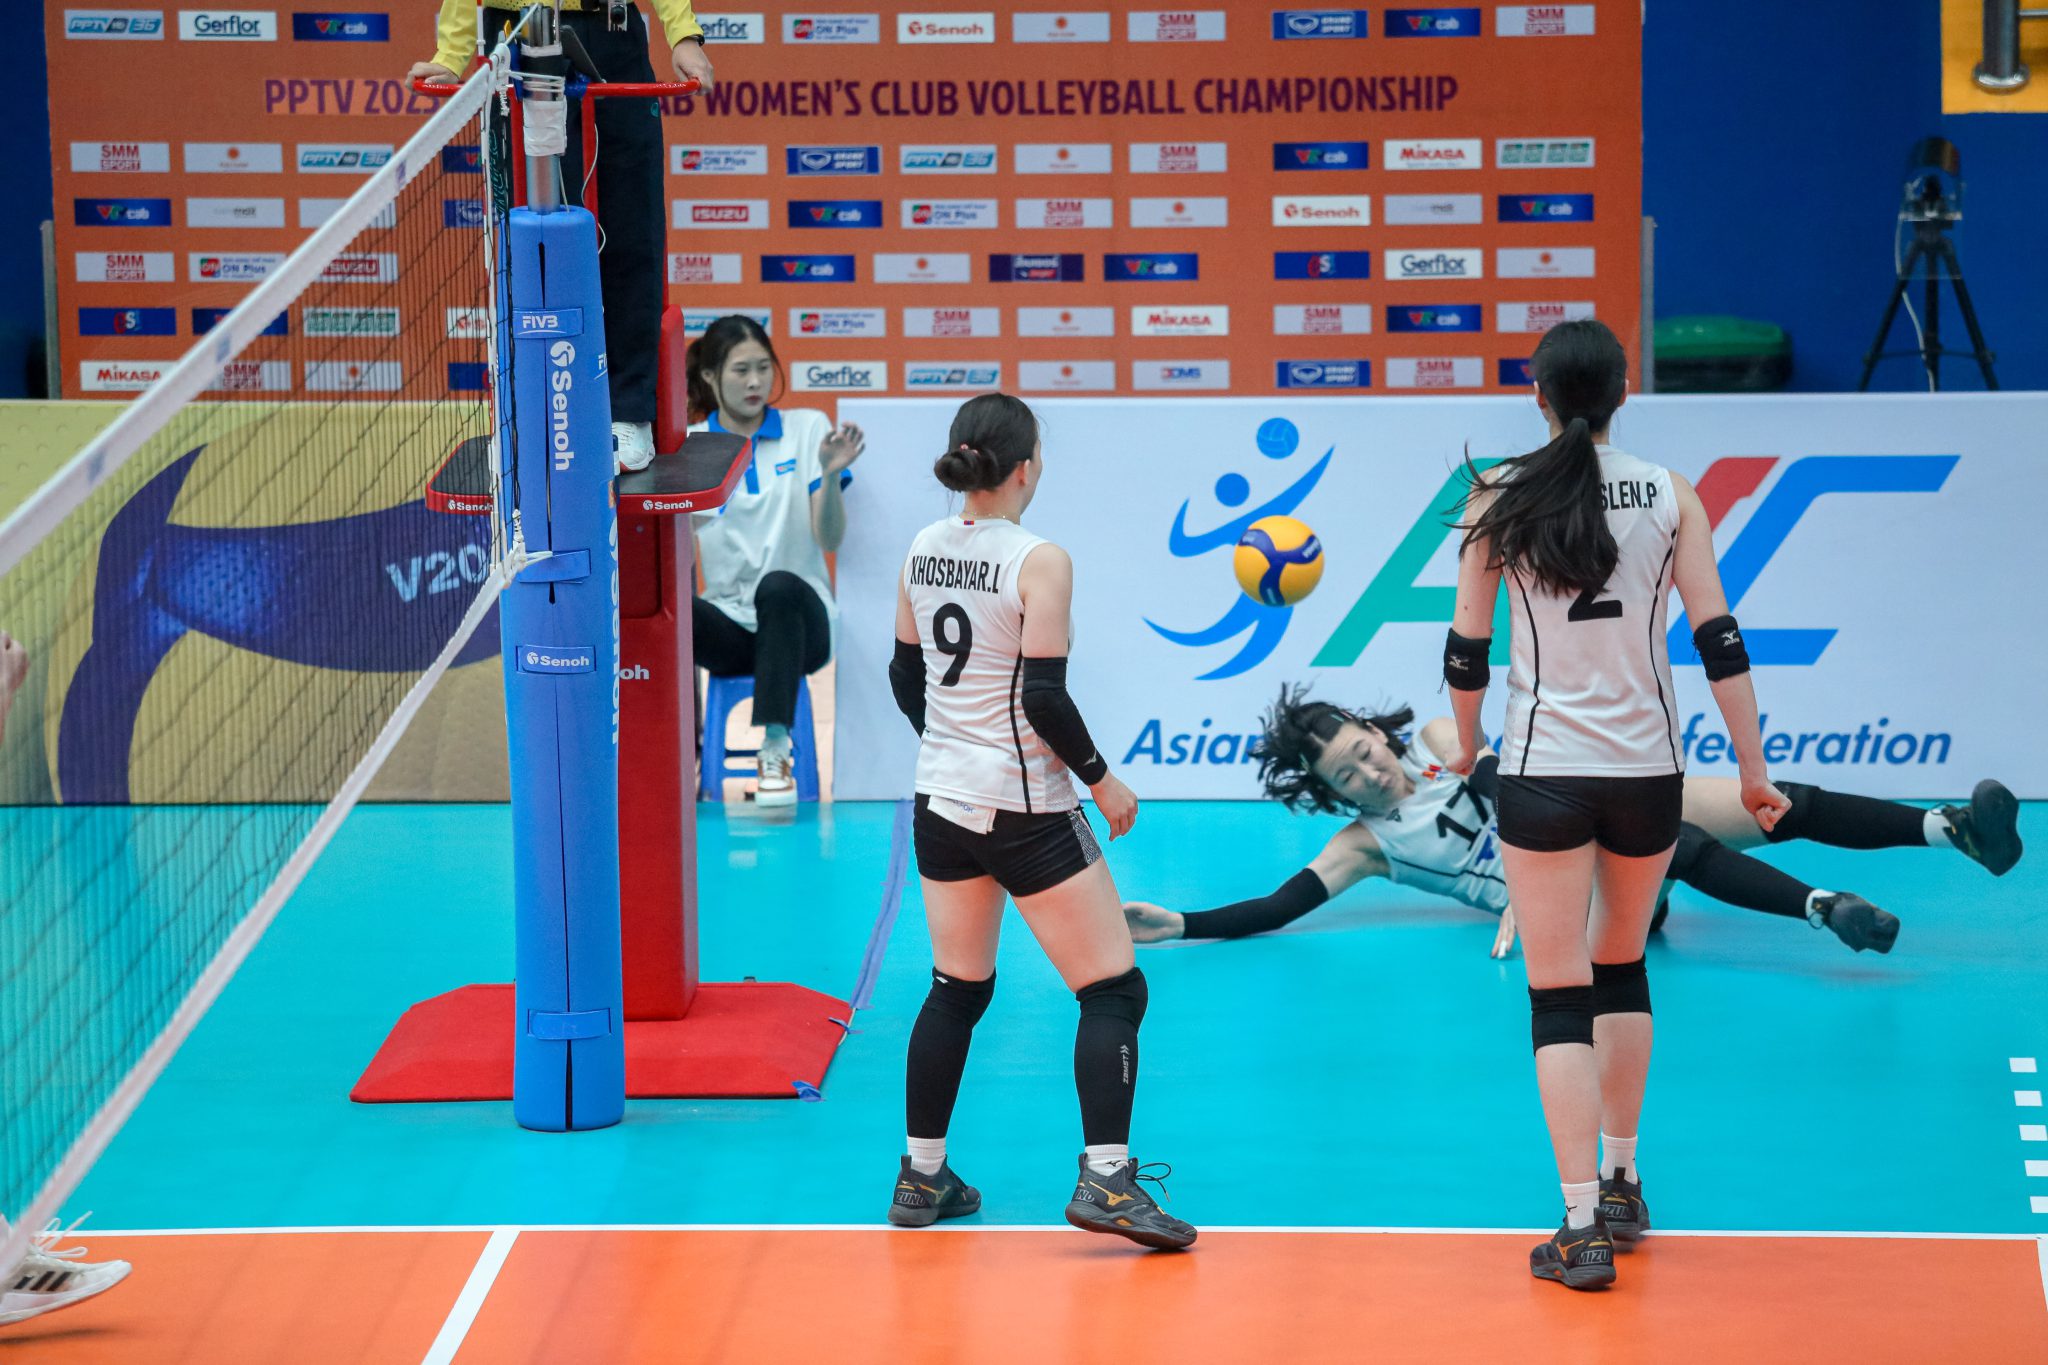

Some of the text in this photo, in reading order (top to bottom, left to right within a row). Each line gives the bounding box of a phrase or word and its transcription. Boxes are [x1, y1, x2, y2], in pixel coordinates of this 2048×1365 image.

[1158, 14, 1195, 28] SMM
[1526, 8, 1564, 22] SMM
[195, 15, 261, 35] Gerflor
[701, 18, 748, 37] erflor
[925, 23, 984, 36] Senoh
[265, 79, 354, 114] PPTV
[705, 80, 861, 116] WOMEN'S
[871, 81, 959, 116] CLUB
[967, 79, 1185, 116] VOLLEYBALL
[1194, 76, 1459, 114] CHAMPIONSHIP
[101, 144, 139, 157] SMM
[1160, 146, 1196, 158] SMM
[101, 159, 141, 171] SPORT
[1046, 201, 1083, 213] SMM
[1302, 206, 1360, 218] Senoh
[694, 208, 748, 220] ISUZU
[106, 255, 144, 268] SMM
[675, 256, 712, 269] SMM
[1401, 255, 1466, 275] Gerflor
[105, 269, 145, 281] SPORT
[933, 310, 970, 323] SMM
[1304, 308, 1341, 320] SMM
[522, 315, 559, 329] FIVB
[1416, 361, 1453, 373] SMM
[807, 366, 871, 386] Gerflor
[551, 370, 575, 471] Senoh
[654, 500, 693, 510] Senoh
[933, 602, 973, 687] 9
[540, 656, 589, 667] Senoh
[1436, 781, 1489, 852] 17
